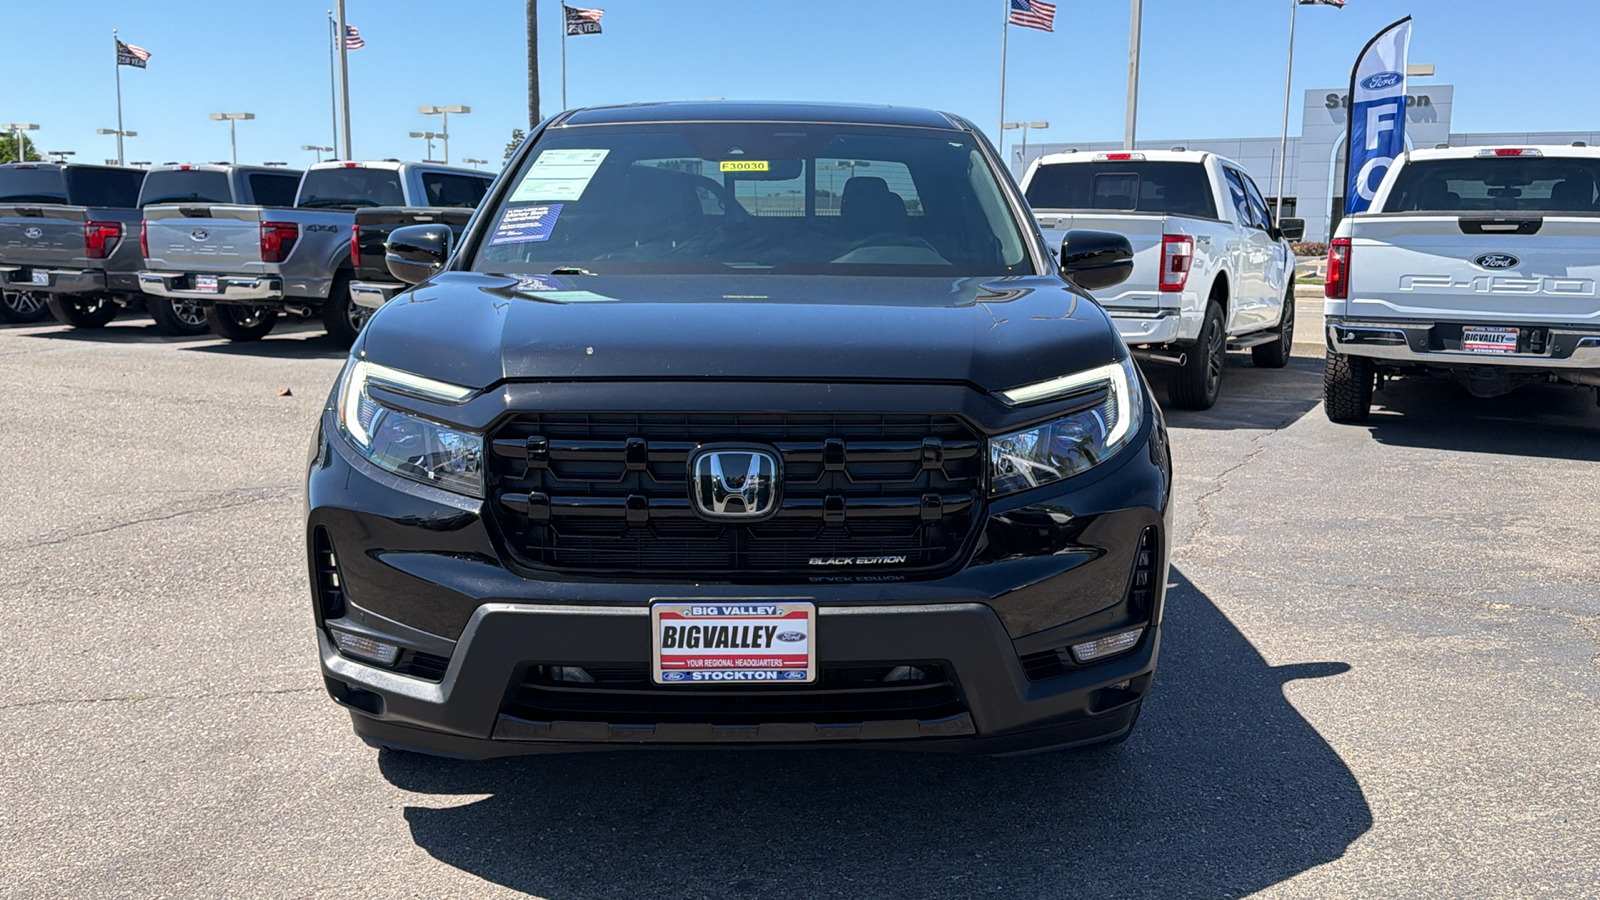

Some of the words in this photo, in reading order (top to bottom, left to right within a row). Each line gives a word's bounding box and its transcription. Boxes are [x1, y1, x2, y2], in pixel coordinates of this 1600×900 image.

[1367, 72, 1399, 89] Ford
[722, 162, 765, 170] F30030
[1479, 253, 1514, 268] Ford
[1399, 274, 1596, 296] F-150
[1464, 333, 1506, 343] BIGVALLEY
[808, 557, 854, 565] BLACK
[856, 555, 906, 564] EDITION
[692, 606, 718, 615] BIG
[722, 606, 775, 615] VALLEY
[662, 625, 778, 649] BIGVALLEY
[780, 631, 804, 641] Ford
[687, 659, 703, 667] YOUR
[704, 659, 734, 667] REGIONAL
[735, 658, 783, 667] HEADQUARTERS
[692, 671, 777, 680] STOCKTON
